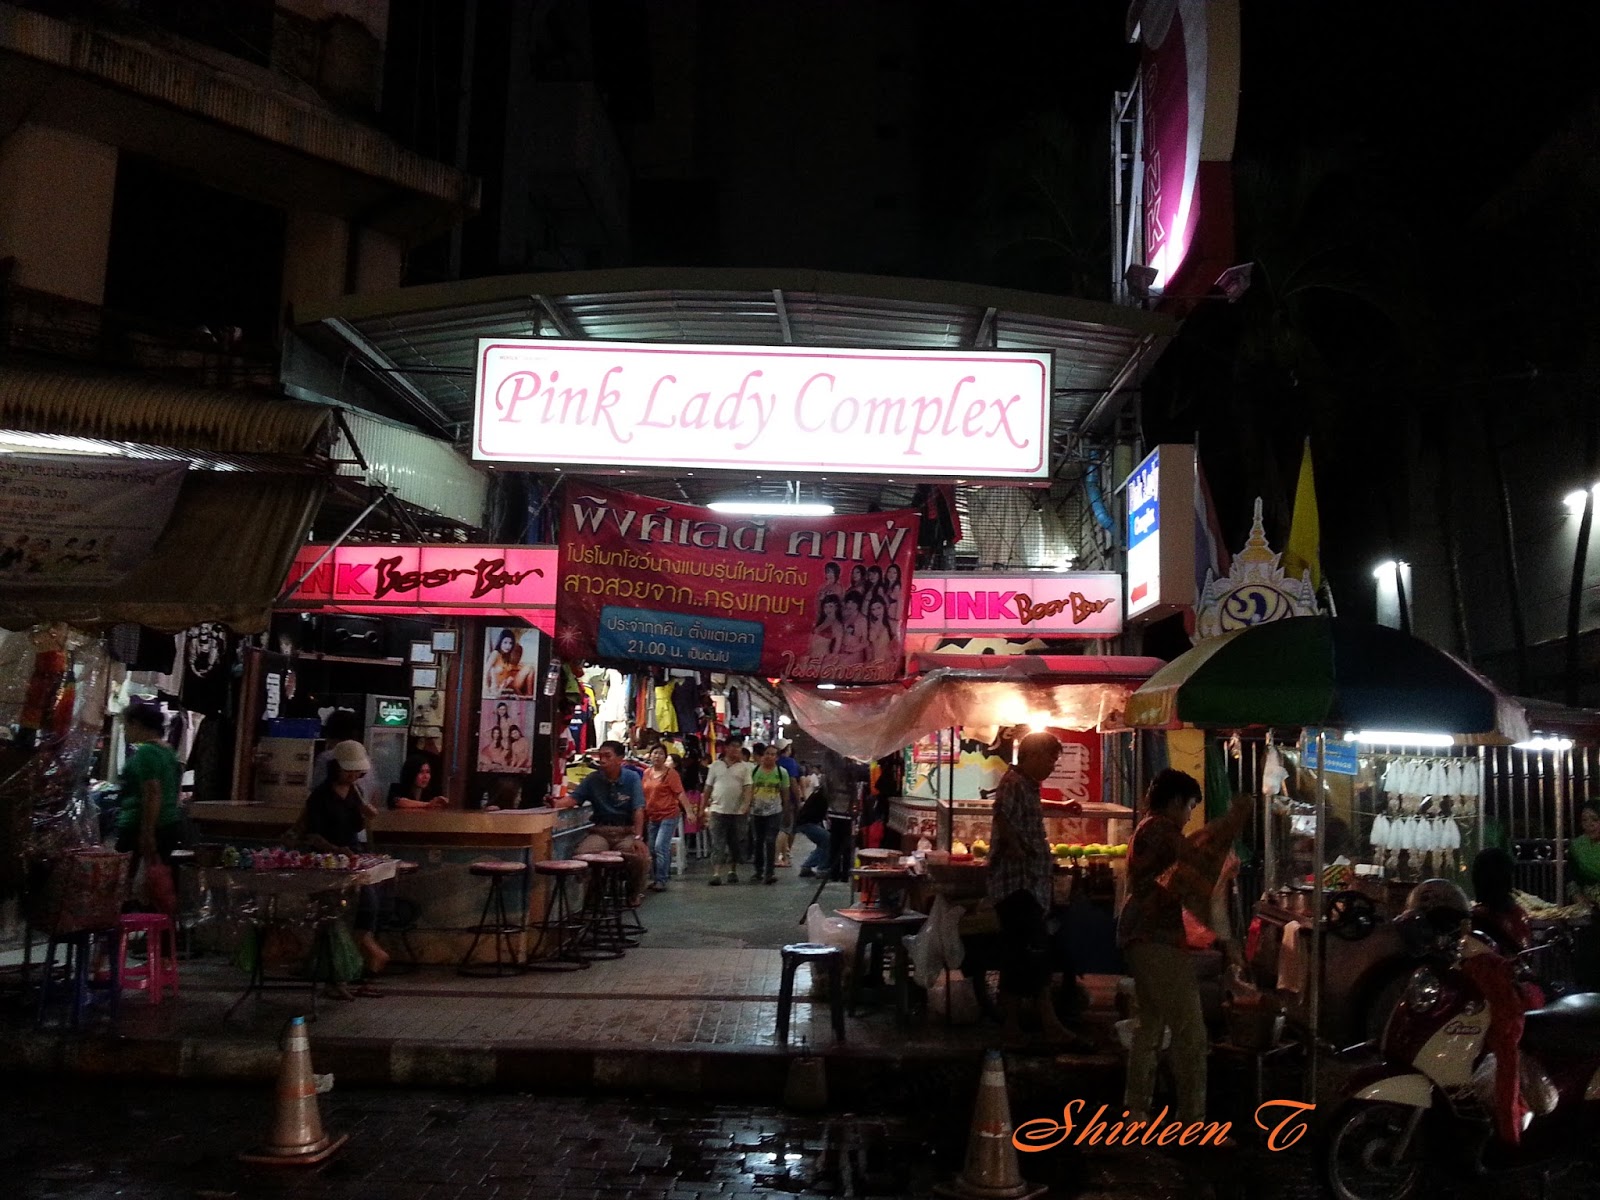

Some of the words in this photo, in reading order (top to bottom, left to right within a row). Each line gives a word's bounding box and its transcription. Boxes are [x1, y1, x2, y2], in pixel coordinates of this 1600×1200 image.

[495, 366, 634, 444] Pink
[635, 369, 777, 450] Lady
[794, 372, 1030, 456] Complex
[285, 562, 373, 595] INK
[374, 555, 477, 599] Beer
[470, 558, 545, 599] Bar
[566, 542, 808, 586] โปรโมทโชว์นางแบบรุ่นใหม่ใจถึง
[908, 584, 1019, 620] PINK
[1014, 593, 1070, 626] Beer
[1068, 591, 1116, 625] Bar
[607, 616, 684, 638] ประจำทุกคืน
[688, 620, 756, 644] ตั้งแต่เวลา
[627, 639, 667, 656] 21.00
[670, 646, 684, 658] น.
